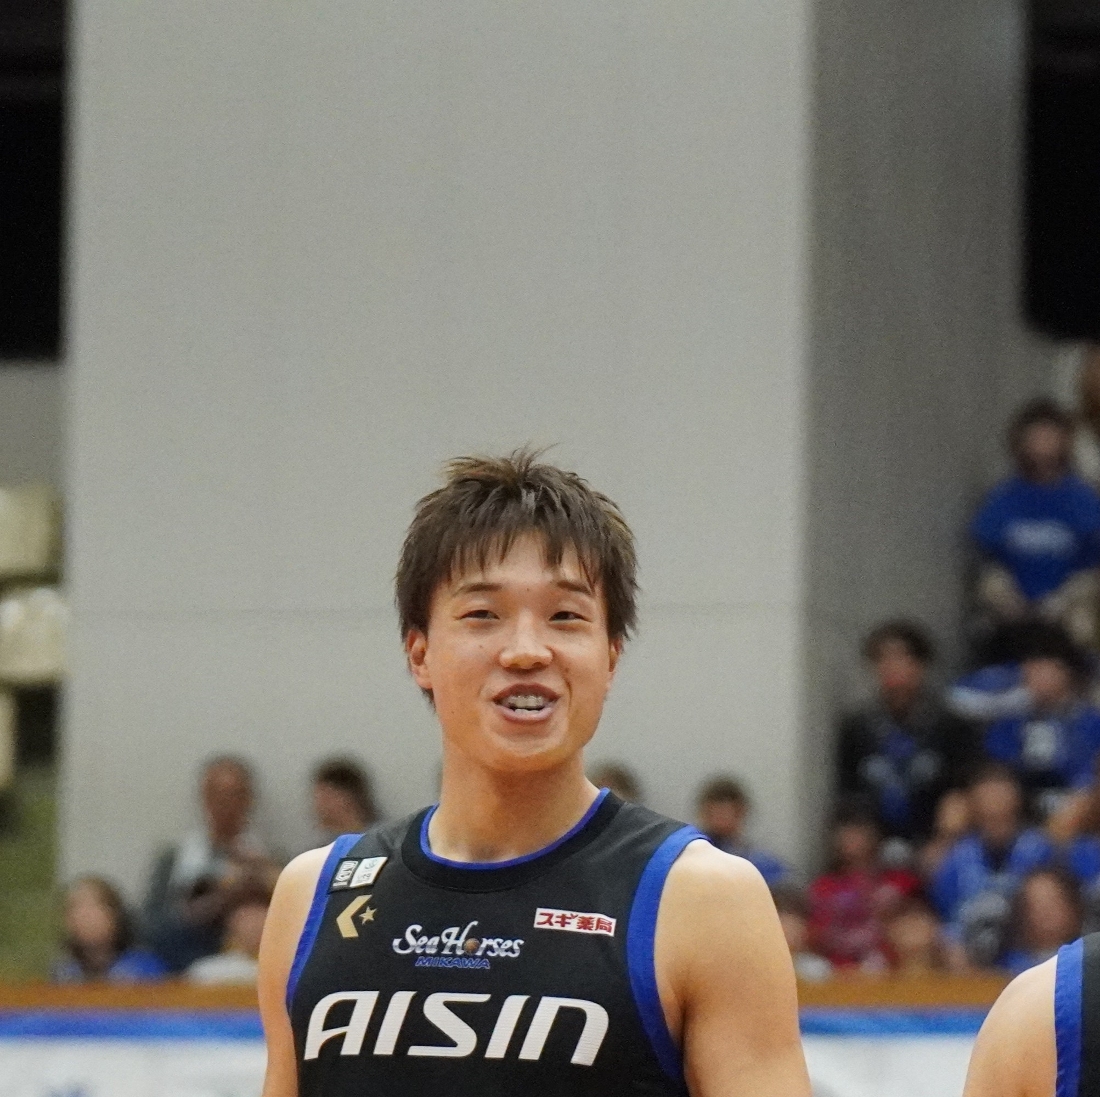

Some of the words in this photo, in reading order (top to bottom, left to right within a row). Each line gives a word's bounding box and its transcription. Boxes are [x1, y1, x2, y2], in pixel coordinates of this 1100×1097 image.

[536, 911, 613, 933] スギ薬局
[415, 956, 491, 969] MIKAWA
[304, 991, 609, 1066] AISIN
